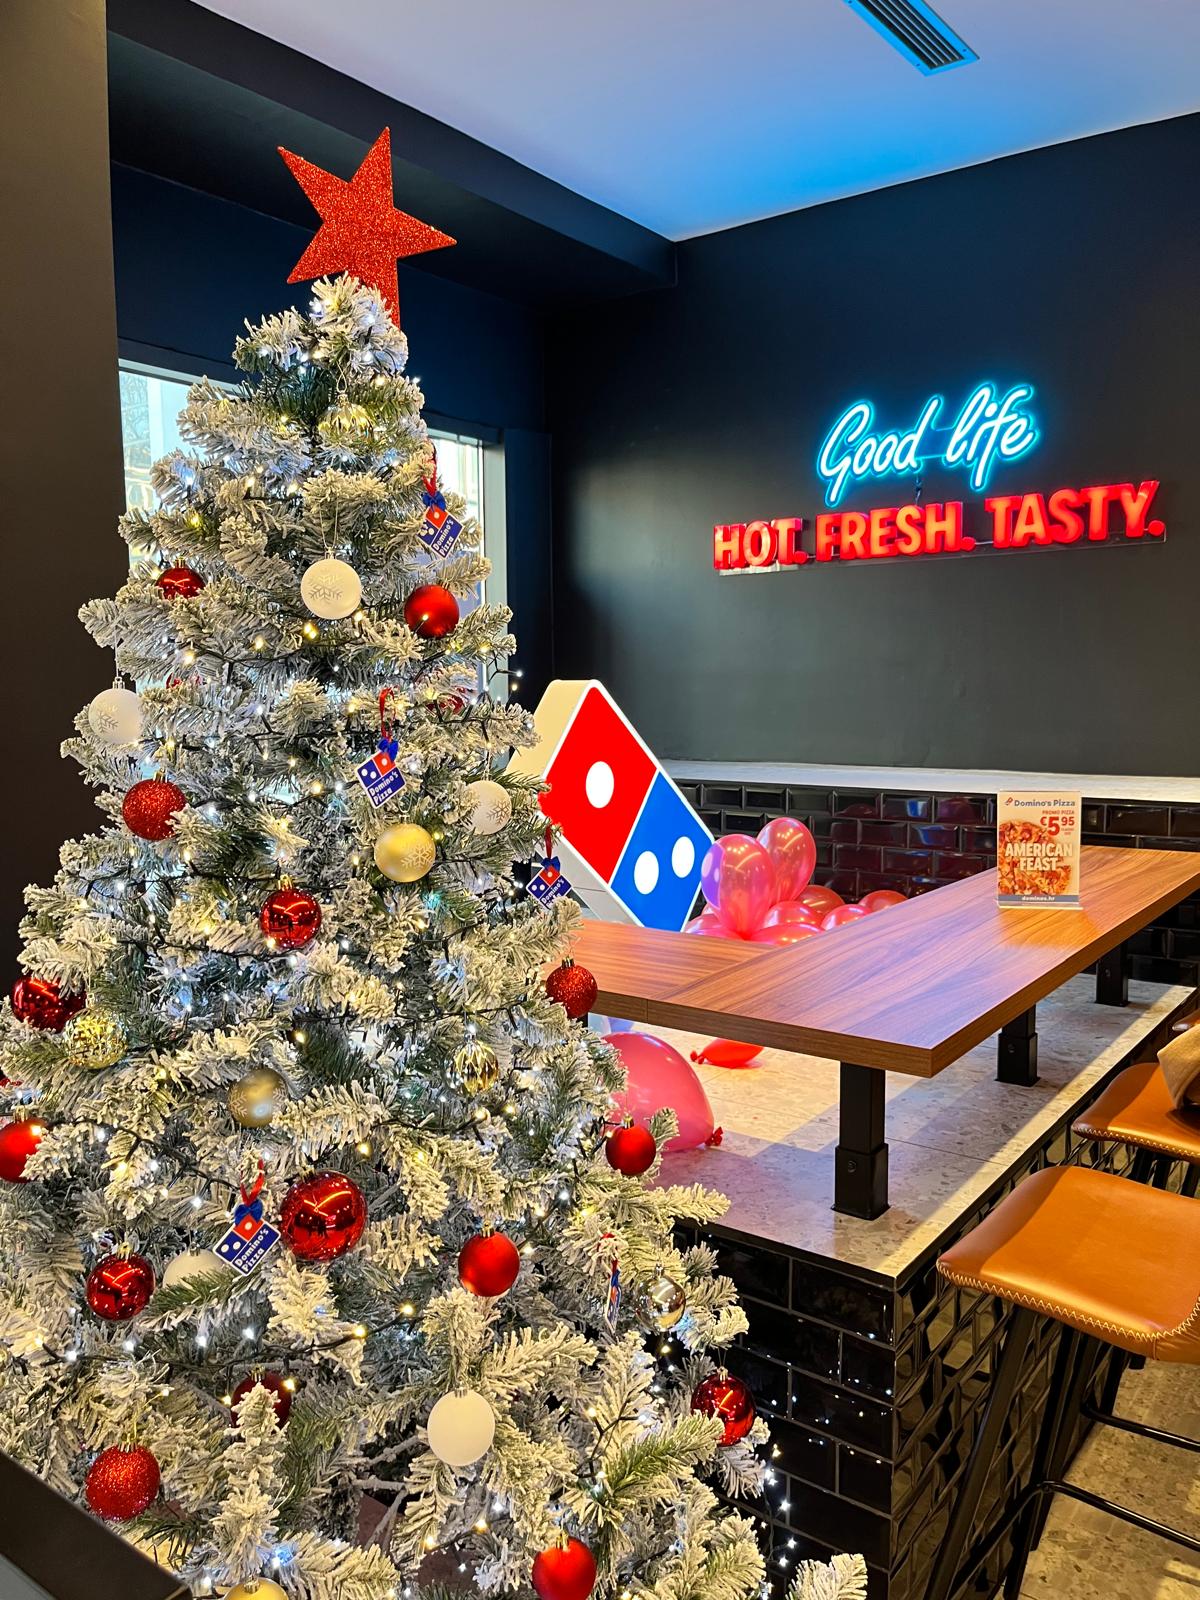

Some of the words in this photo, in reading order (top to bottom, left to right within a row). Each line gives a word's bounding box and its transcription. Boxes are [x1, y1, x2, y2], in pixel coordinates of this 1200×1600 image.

[819, 397, 943, 505] Good
[945, 383, 1037, 488] life
[432, 519, 454, 551] Domino's
[714, 517, 808, 570] HOT.
[816, 501, 976, 560] FRESH.
[985, 481, 1166, 547] TASTY.
[439, 536, 454, 556] Pizza
[368, 770, 399, 796] Domino's
[373, 787, 393, 805] Pizza
[1014, 799, 1052, 807] Domino's
[1053, 799, 1075, 807] Pizza
[1005, 842, 1073, 857] AMERICAN
[1019, 856, 1059, 871] FEAST
[541, 878, 564, 904] Domino's
[234, 1228, 269, 1267] Domino's
[241, 1247, 265, 1272] Pizza
